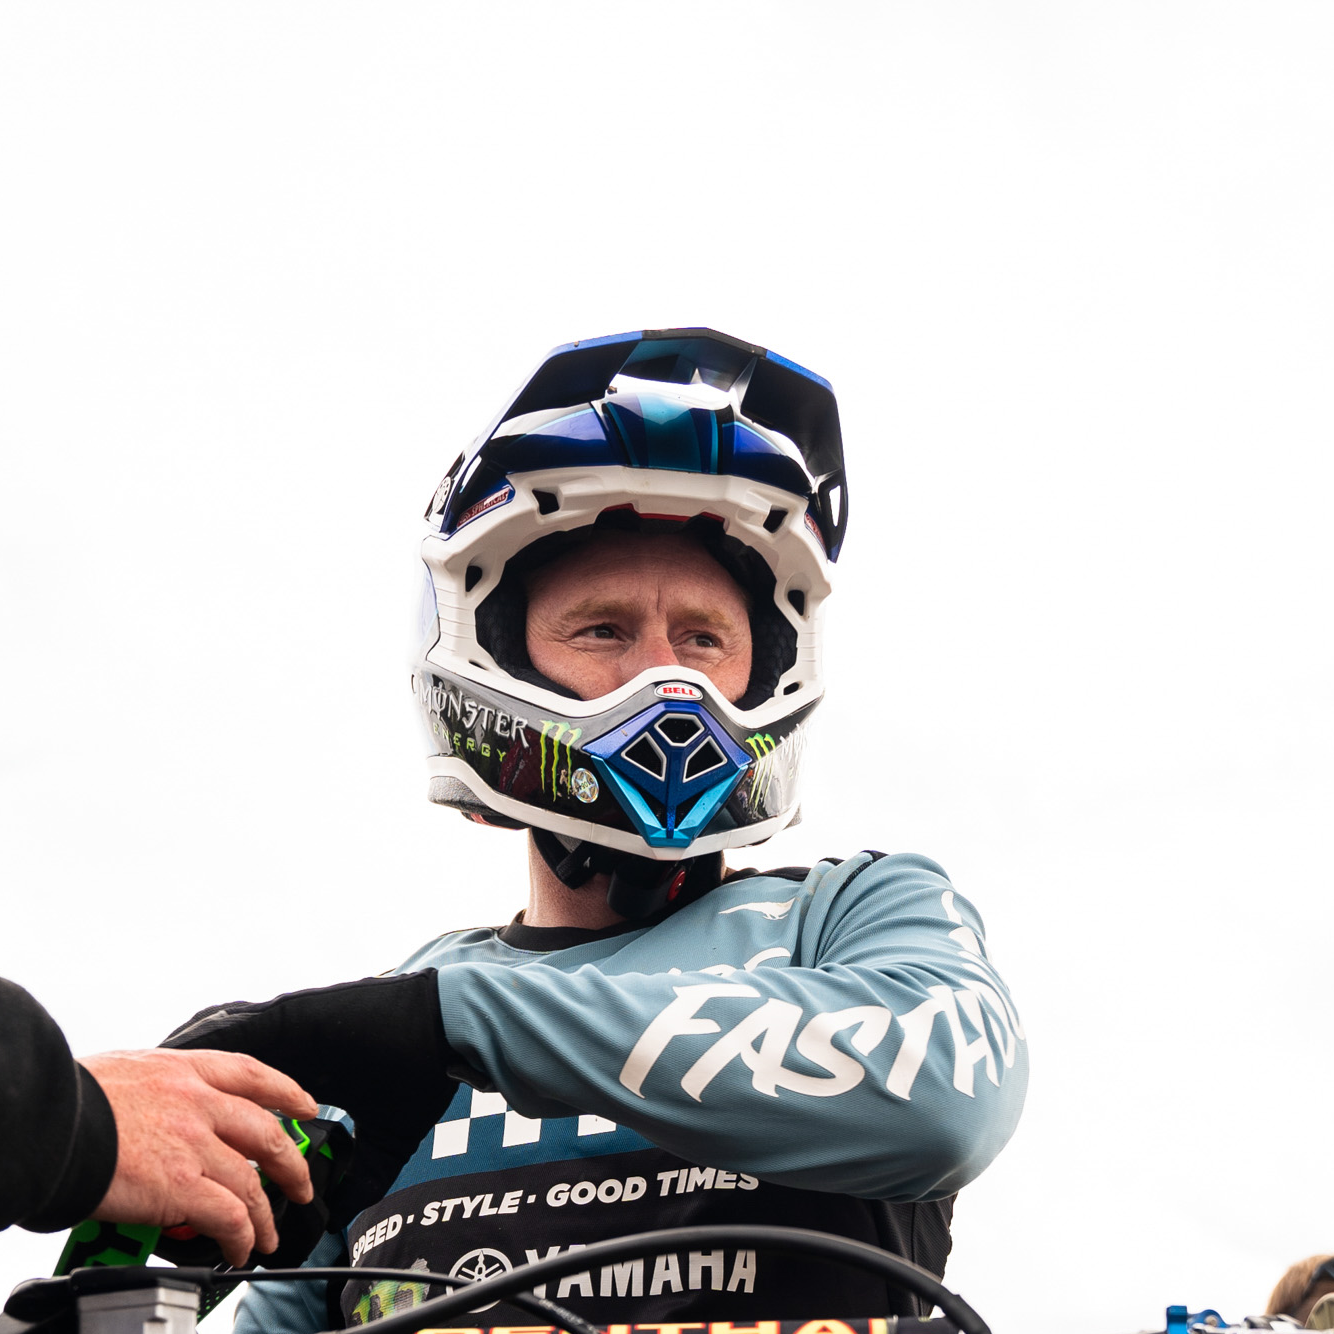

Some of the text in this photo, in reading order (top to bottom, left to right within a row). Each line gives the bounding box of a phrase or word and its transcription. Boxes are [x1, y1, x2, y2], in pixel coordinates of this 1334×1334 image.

[419, 680, 530, 749] MONSTER
[662, 687, 697, 696] BELL
[433, 722, 507, 762] ENERGY
[352, 1165, 760, 1266] SPEED STYLE GOOD TIMES
[525, 1243, 757, 1299] YAMAHA
